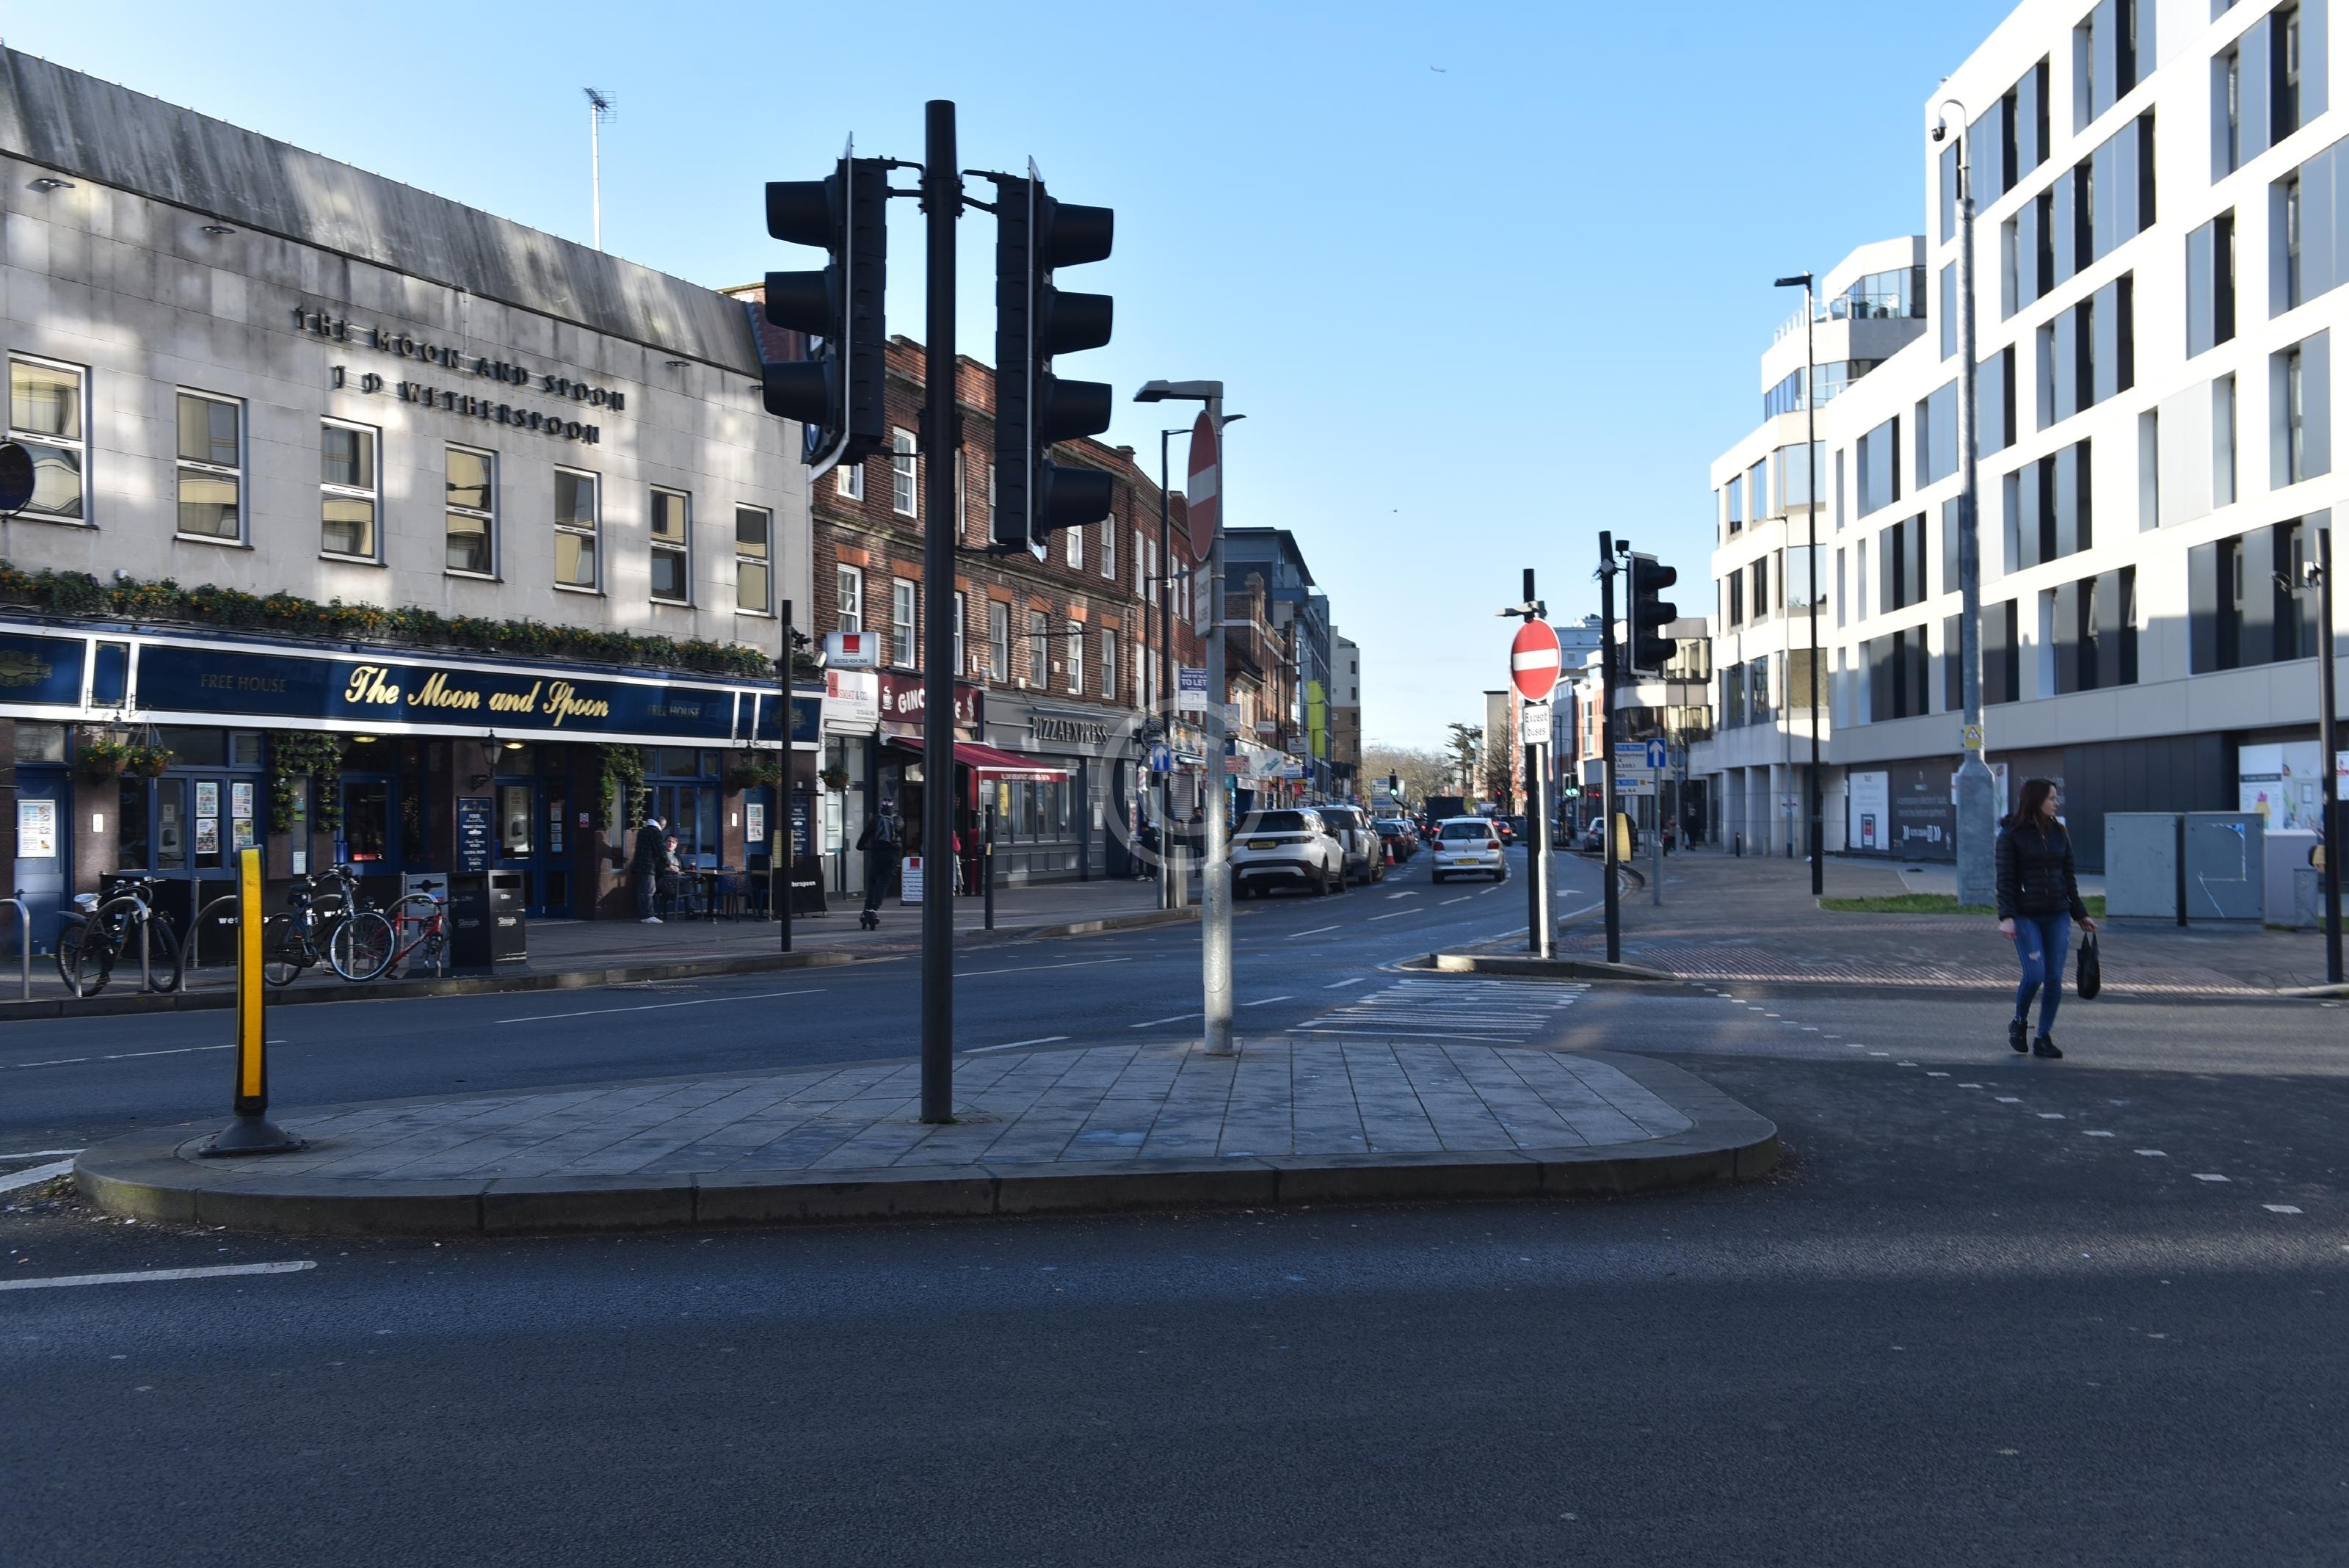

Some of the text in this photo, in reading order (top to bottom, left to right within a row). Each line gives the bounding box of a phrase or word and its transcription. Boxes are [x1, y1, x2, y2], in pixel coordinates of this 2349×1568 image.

[296, 307, 625, 411] THE MOON AND SPOON
[332, 366, 600, 444] J D WETHERSPOON
[200, 673, 287, 693] FREE HOUSE
[1180, 678, 1192, 686] TO
[345, 666, 610, 727] The Moon and Spoon
[647, 704, 700, 718] FREE HOUSE
[1525, 712, 1548, 723] Except
[1032, 716, 1108, 744] PIZZAEXPRESS
[1527, 727, 1546, 736] buses
[498, 916, 517, 926] Slough
